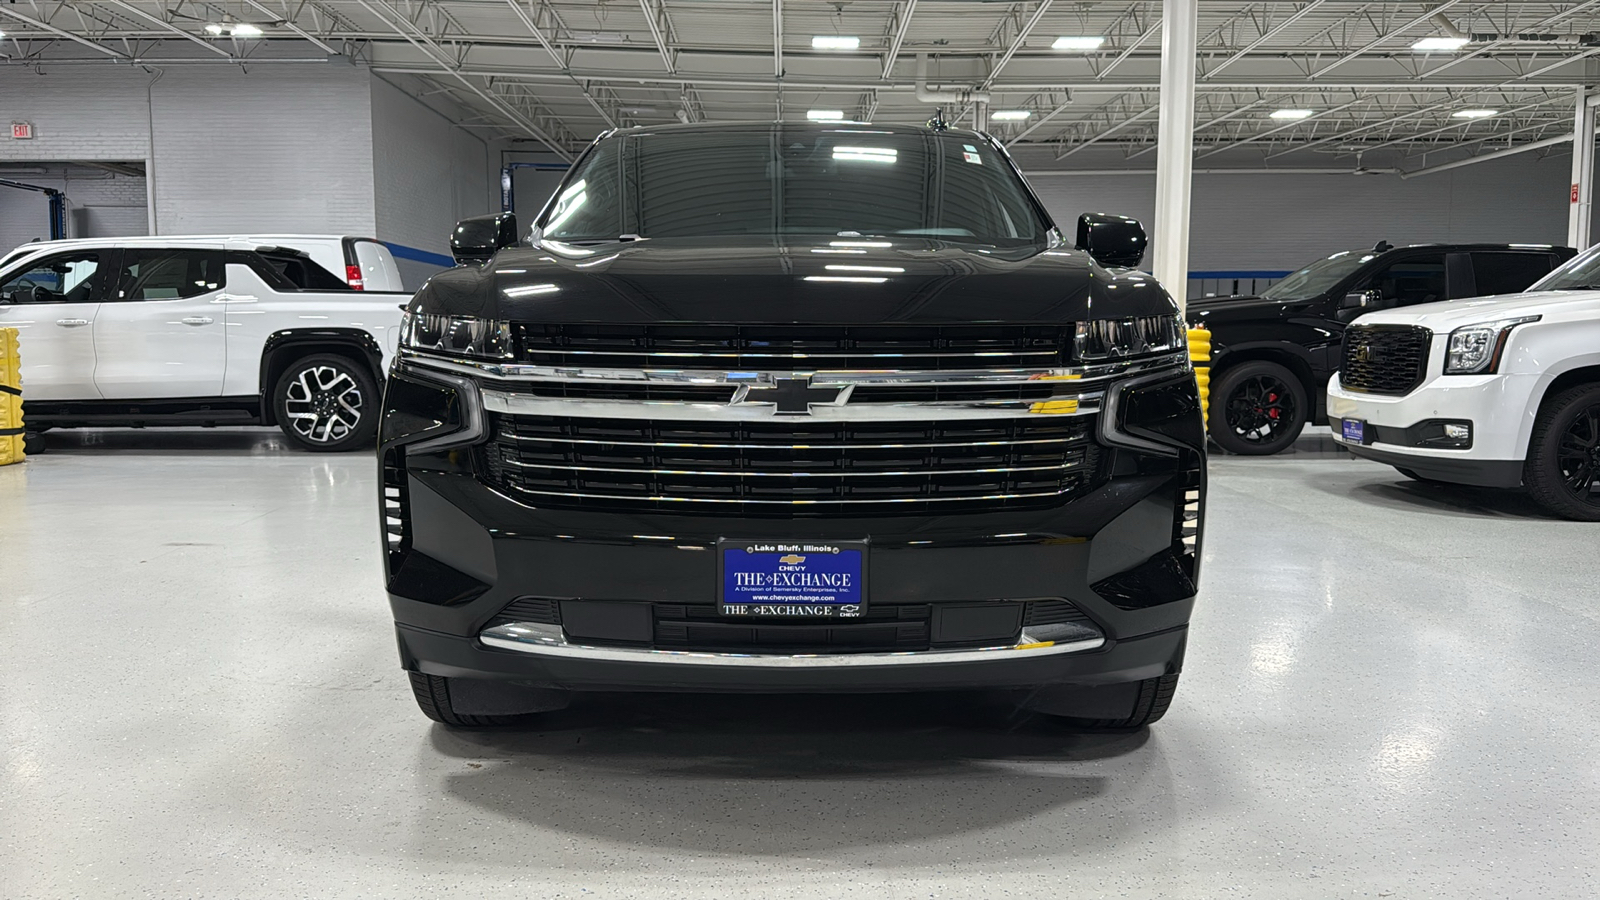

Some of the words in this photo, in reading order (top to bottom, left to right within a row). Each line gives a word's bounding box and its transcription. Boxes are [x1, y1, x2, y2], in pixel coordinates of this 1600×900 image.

[14, 125, 28, 136] EXIT
[755, 544, 775, 552] Lake
[734, 572, 765, 586] THE
[773, 573, 850, 587] EXCHANGE
[723, 605, 748, 614] THE
[761, 606, 832, 615] EXCHANGE
